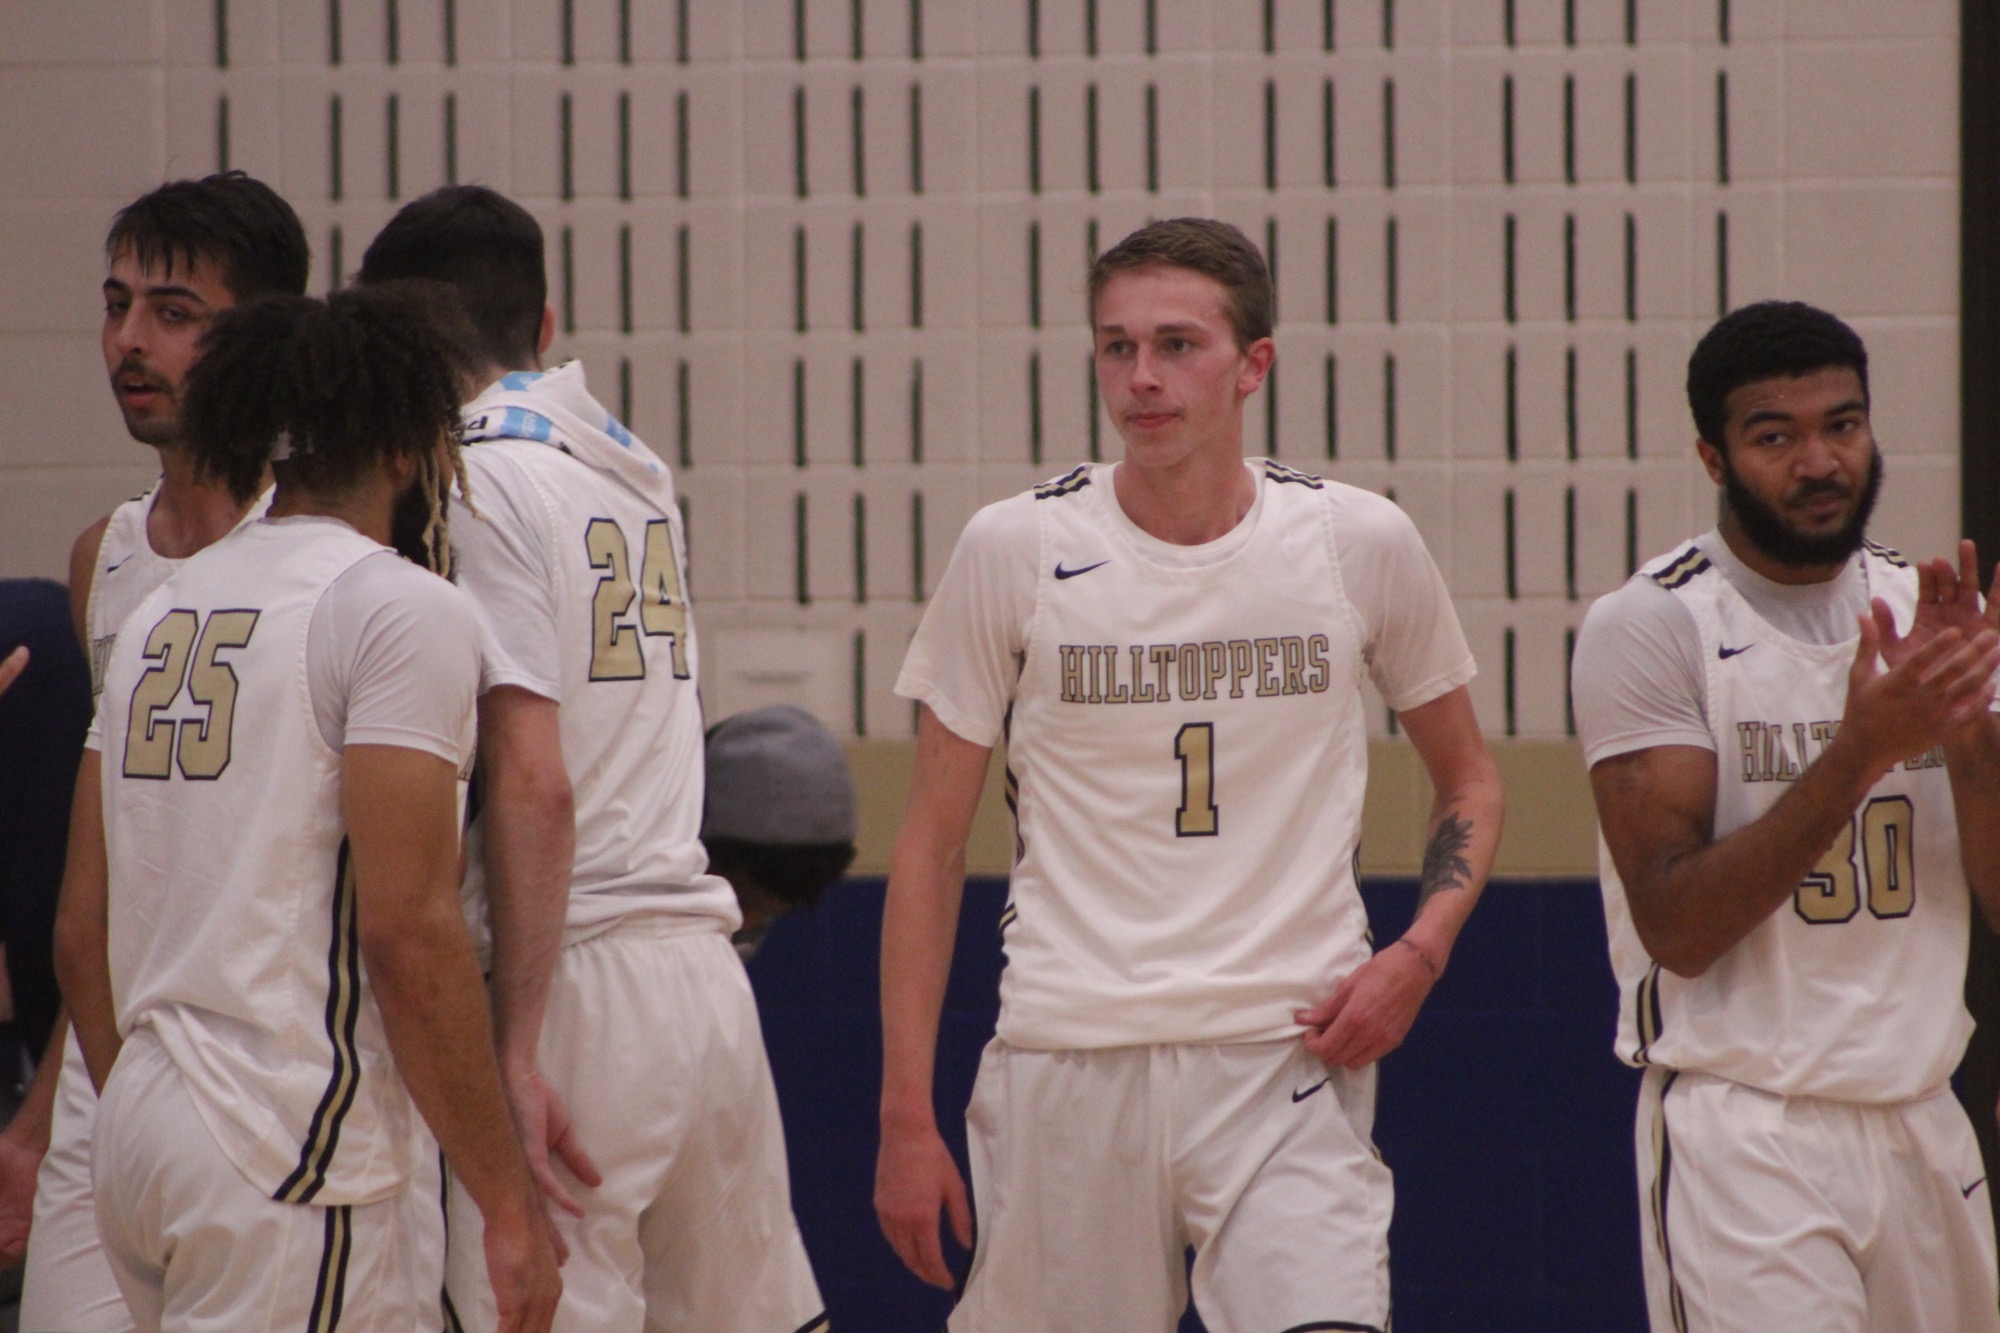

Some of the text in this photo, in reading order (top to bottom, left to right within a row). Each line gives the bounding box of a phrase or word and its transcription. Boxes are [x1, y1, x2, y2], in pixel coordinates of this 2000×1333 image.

[585, 517, 690, 682] 24
[122, 608, 262, 780] 25
[1059, 634, 1330, 704] HILLTOPPERS
[1174, 722, 1218, 837] 1
[1794, 794, 1916, 925] 30
